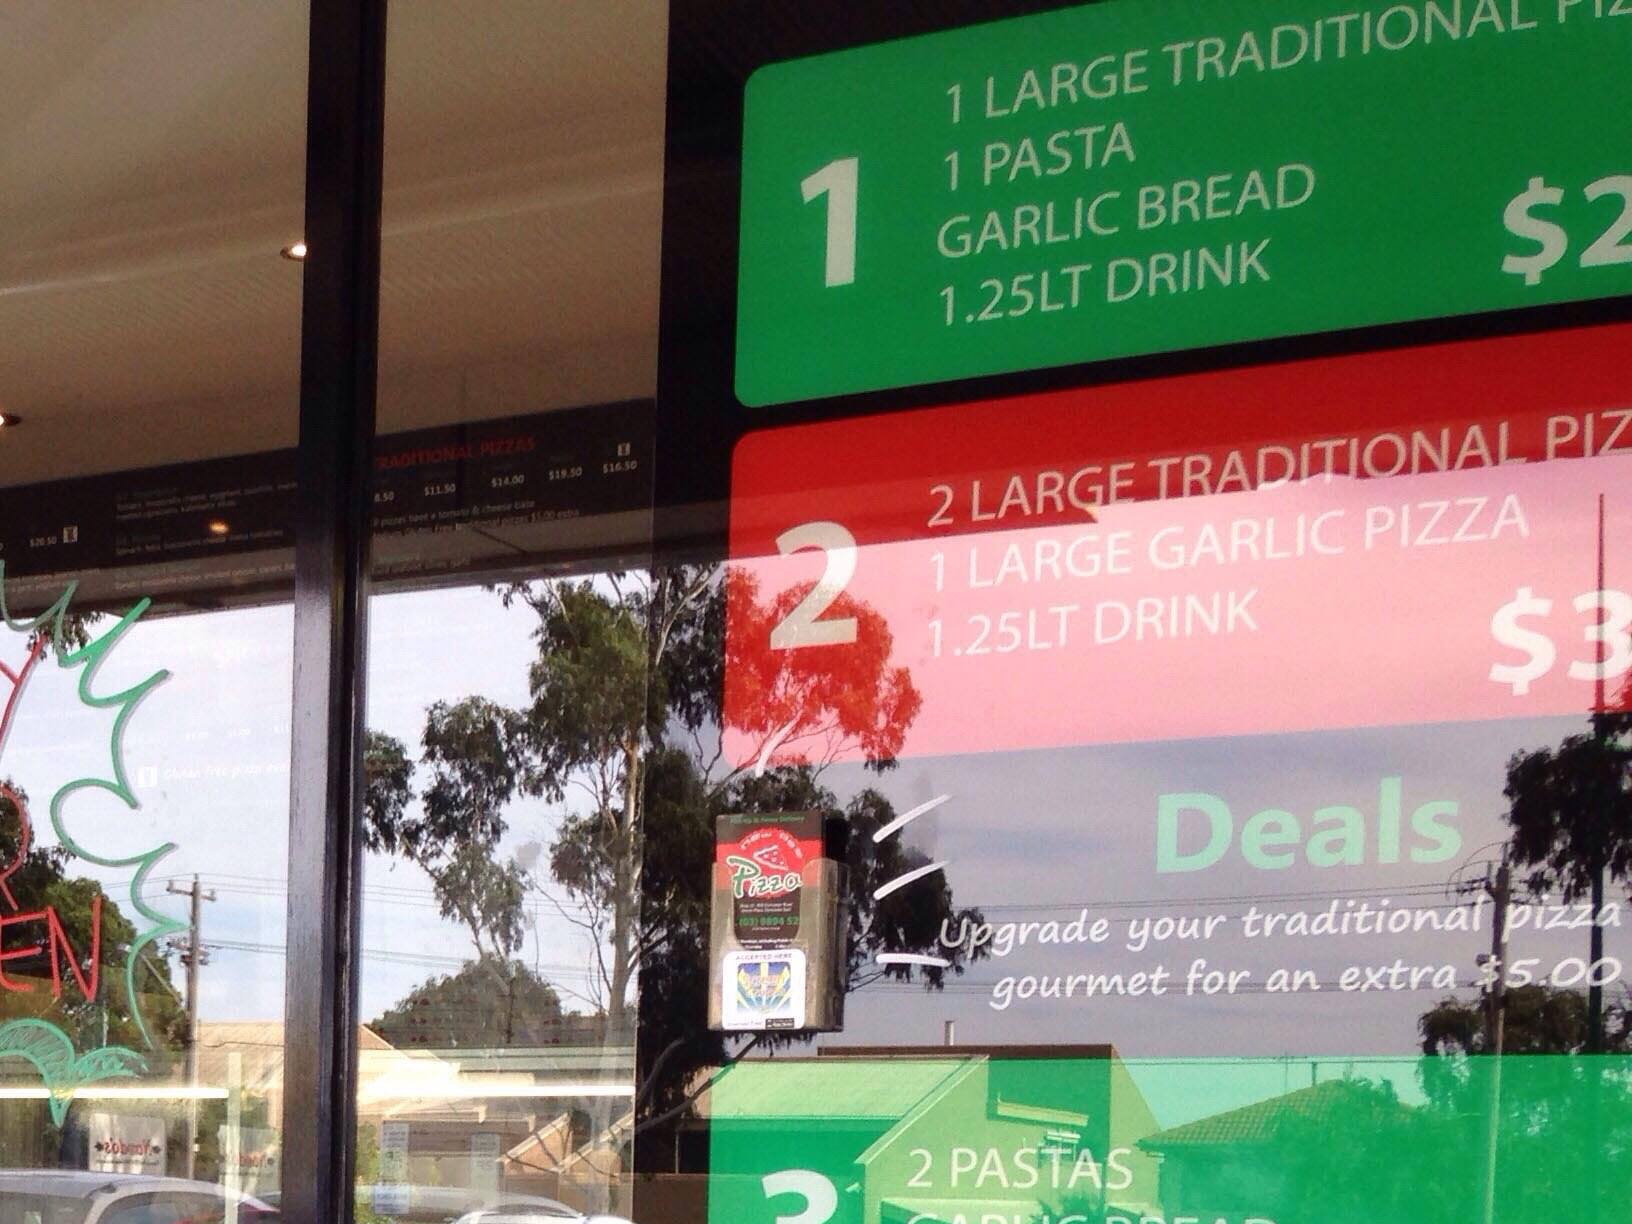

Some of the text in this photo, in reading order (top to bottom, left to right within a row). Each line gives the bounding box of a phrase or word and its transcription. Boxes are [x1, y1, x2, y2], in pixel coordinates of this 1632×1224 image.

[947, 0, 1538, 123] 1 LARGE TRADITIONAL
[944, 123, 1136, 190] 1 PASTA
[801, 157, 859, 287] 1
[937, 164, 1316, 259] GARLIC BREAD
[939, 241, 1272, 327] 1.25LT DRINK
[929, 486, 955, 528] 2
[973, 461, 1135, 522] LARGE
[1149, 420, 1528, 500] TRADITIONAL
[769, 521, 858, 649] 2
[931, 493, 1531, 591] 1 LARGE GARLIC PIZZA
[928, 588, 1259, 658] 1.25LT DRINK
[1155, 775, 1464, 875] Deals
[727, 855, 802, 898] Pizza
[939, 893, 1622, 959] Upgrade your traditional pizza
[990, 953, 1623, 1011] gourmet for an extra $5.00
[908, 1148, 1134, 1190] 2 PASTAS
